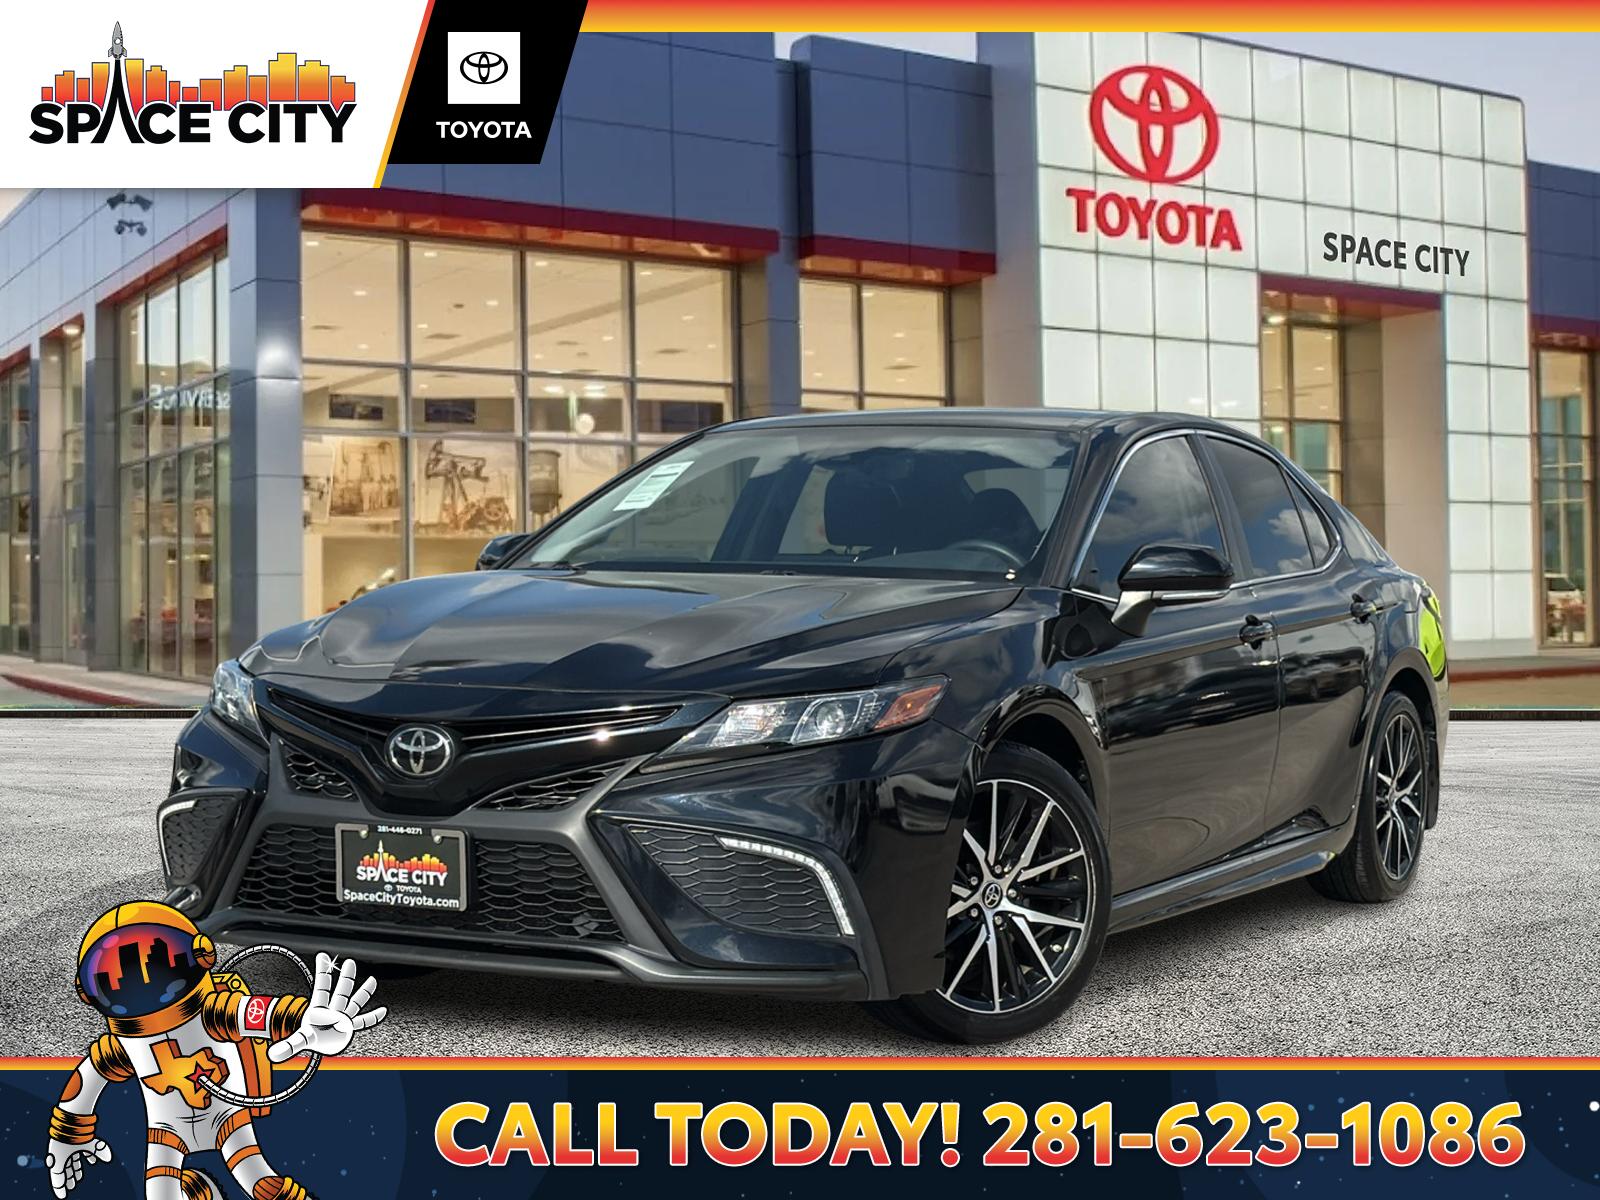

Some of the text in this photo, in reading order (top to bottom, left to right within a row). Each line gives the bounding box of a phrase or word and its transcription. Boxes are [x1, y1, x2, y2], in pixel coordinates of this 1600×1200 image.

[1066, 187, 1242, 251] TOYOTA
[1322, 231, 1470, 277] SPACE CITY
[412, 870, 448, 887] CITY
[343, 889, 460, 908] SpaceCityToyota.com
[396, 885, 422, 894] TOYOTA
